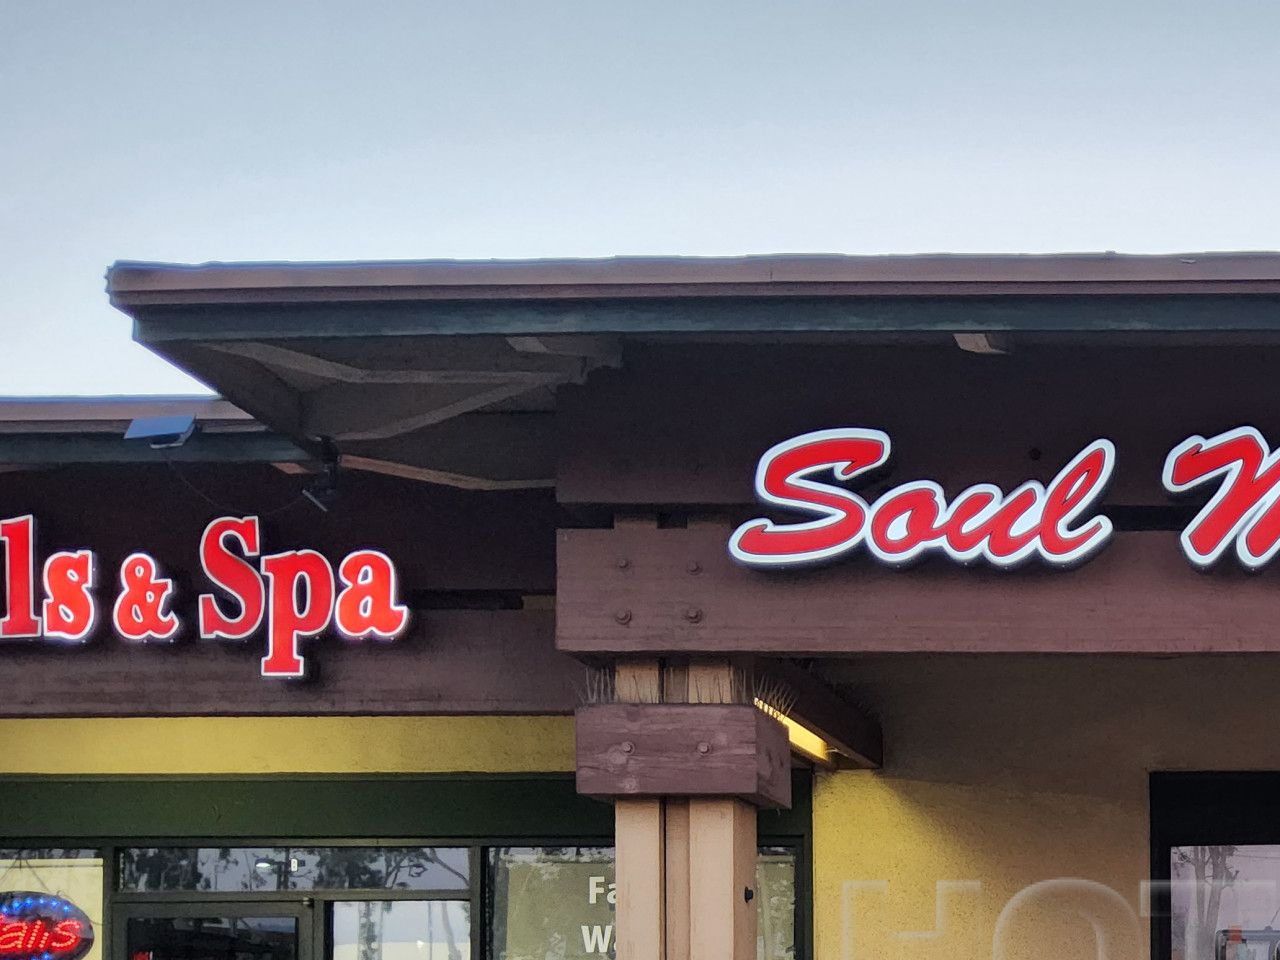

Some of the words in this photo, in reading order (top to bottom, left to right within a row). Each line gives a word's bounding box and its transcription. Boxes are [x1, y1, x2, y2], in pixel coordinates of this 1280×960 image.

[728, 427, 1116, 566] Soul
[113, 552, 180, 639] &
[199, 516, 409, 676] Spa
[581, 925, 616, 953] W
